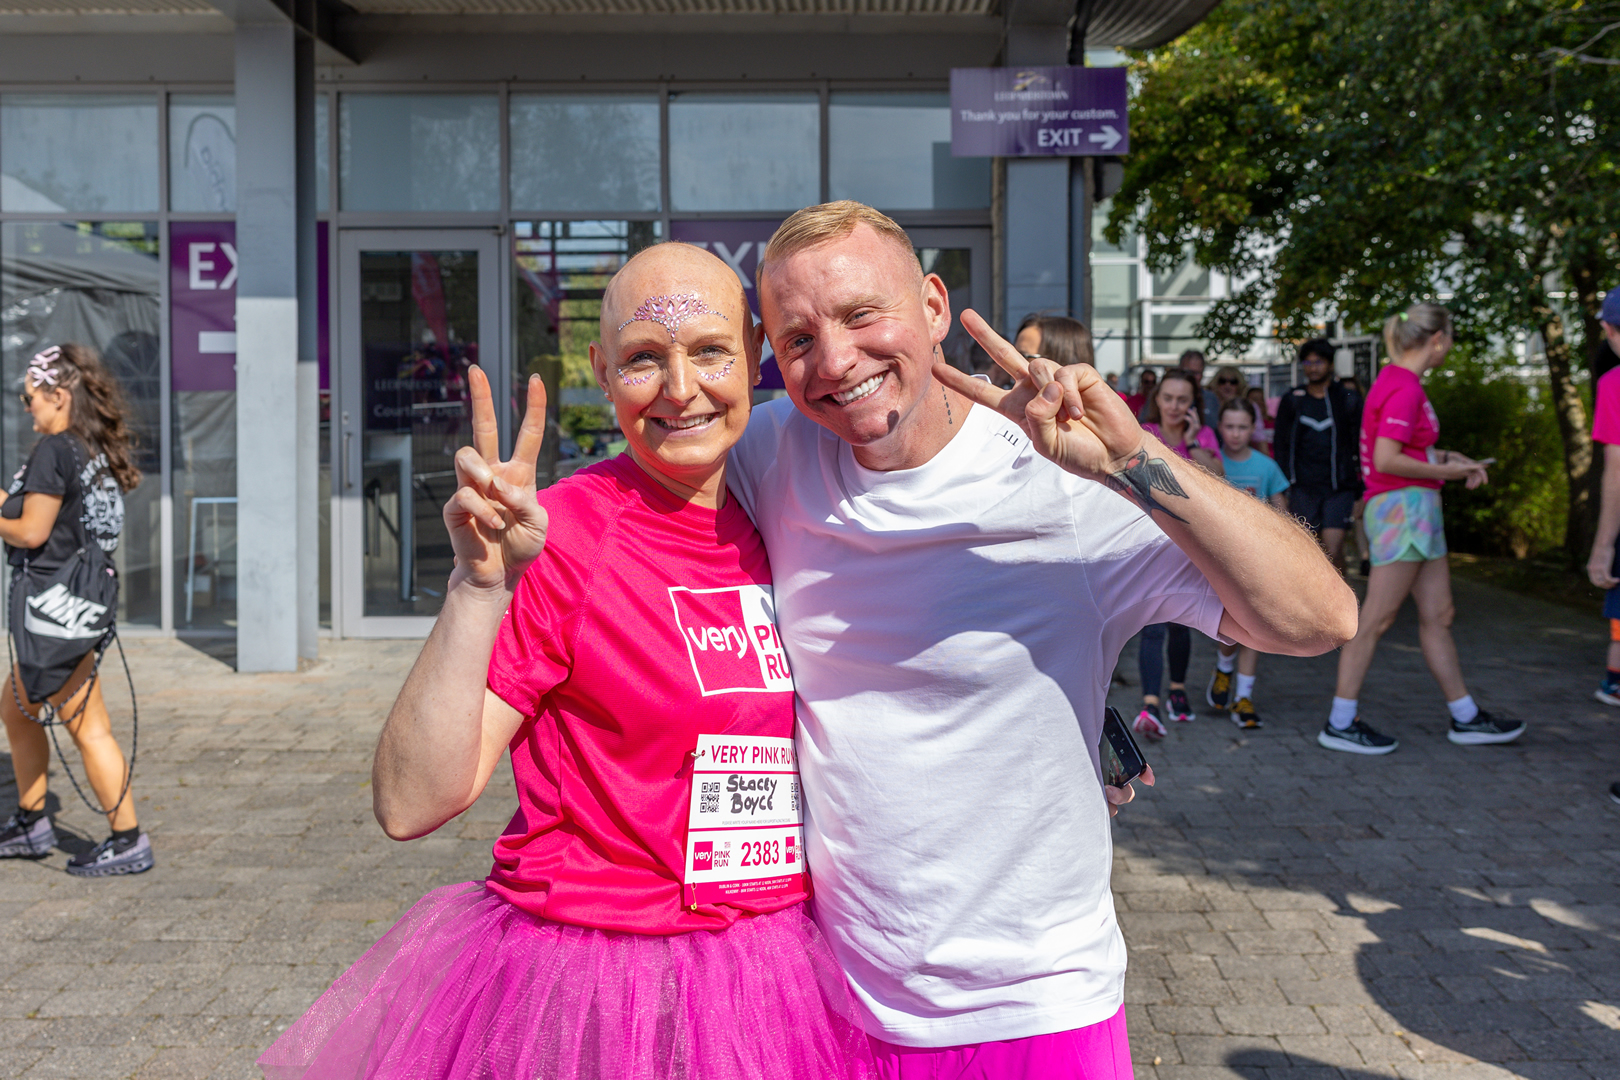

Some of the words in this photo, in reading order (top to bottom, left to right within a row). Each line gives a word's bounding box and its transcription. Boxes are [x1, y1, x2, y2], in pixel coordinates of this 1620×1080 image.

[961, 110, 995, 122] Thank
[998, 112, 1020, 124] you
[1022, 108, 1039, 120] for
[1042, 112, 1069, 123] your
[1071, 109, 1119, 120] custom.
[1037, 128, 1083, 147] EXIT
[30, 583, 108, 632] NIKE
[687, 626, 748, 659] very
[754, 623, 783, 650] PI
[711, 745, 748, 763] VERY
[752, 746, 779, 764] PINK
[731, 793, 774, 815] Boyce
[694, 850, 713, 861] very
[714, 850, 731, 859] PINK
[714, 859, 729, 867] RUN
[740, 840, 780, 867] 2383
